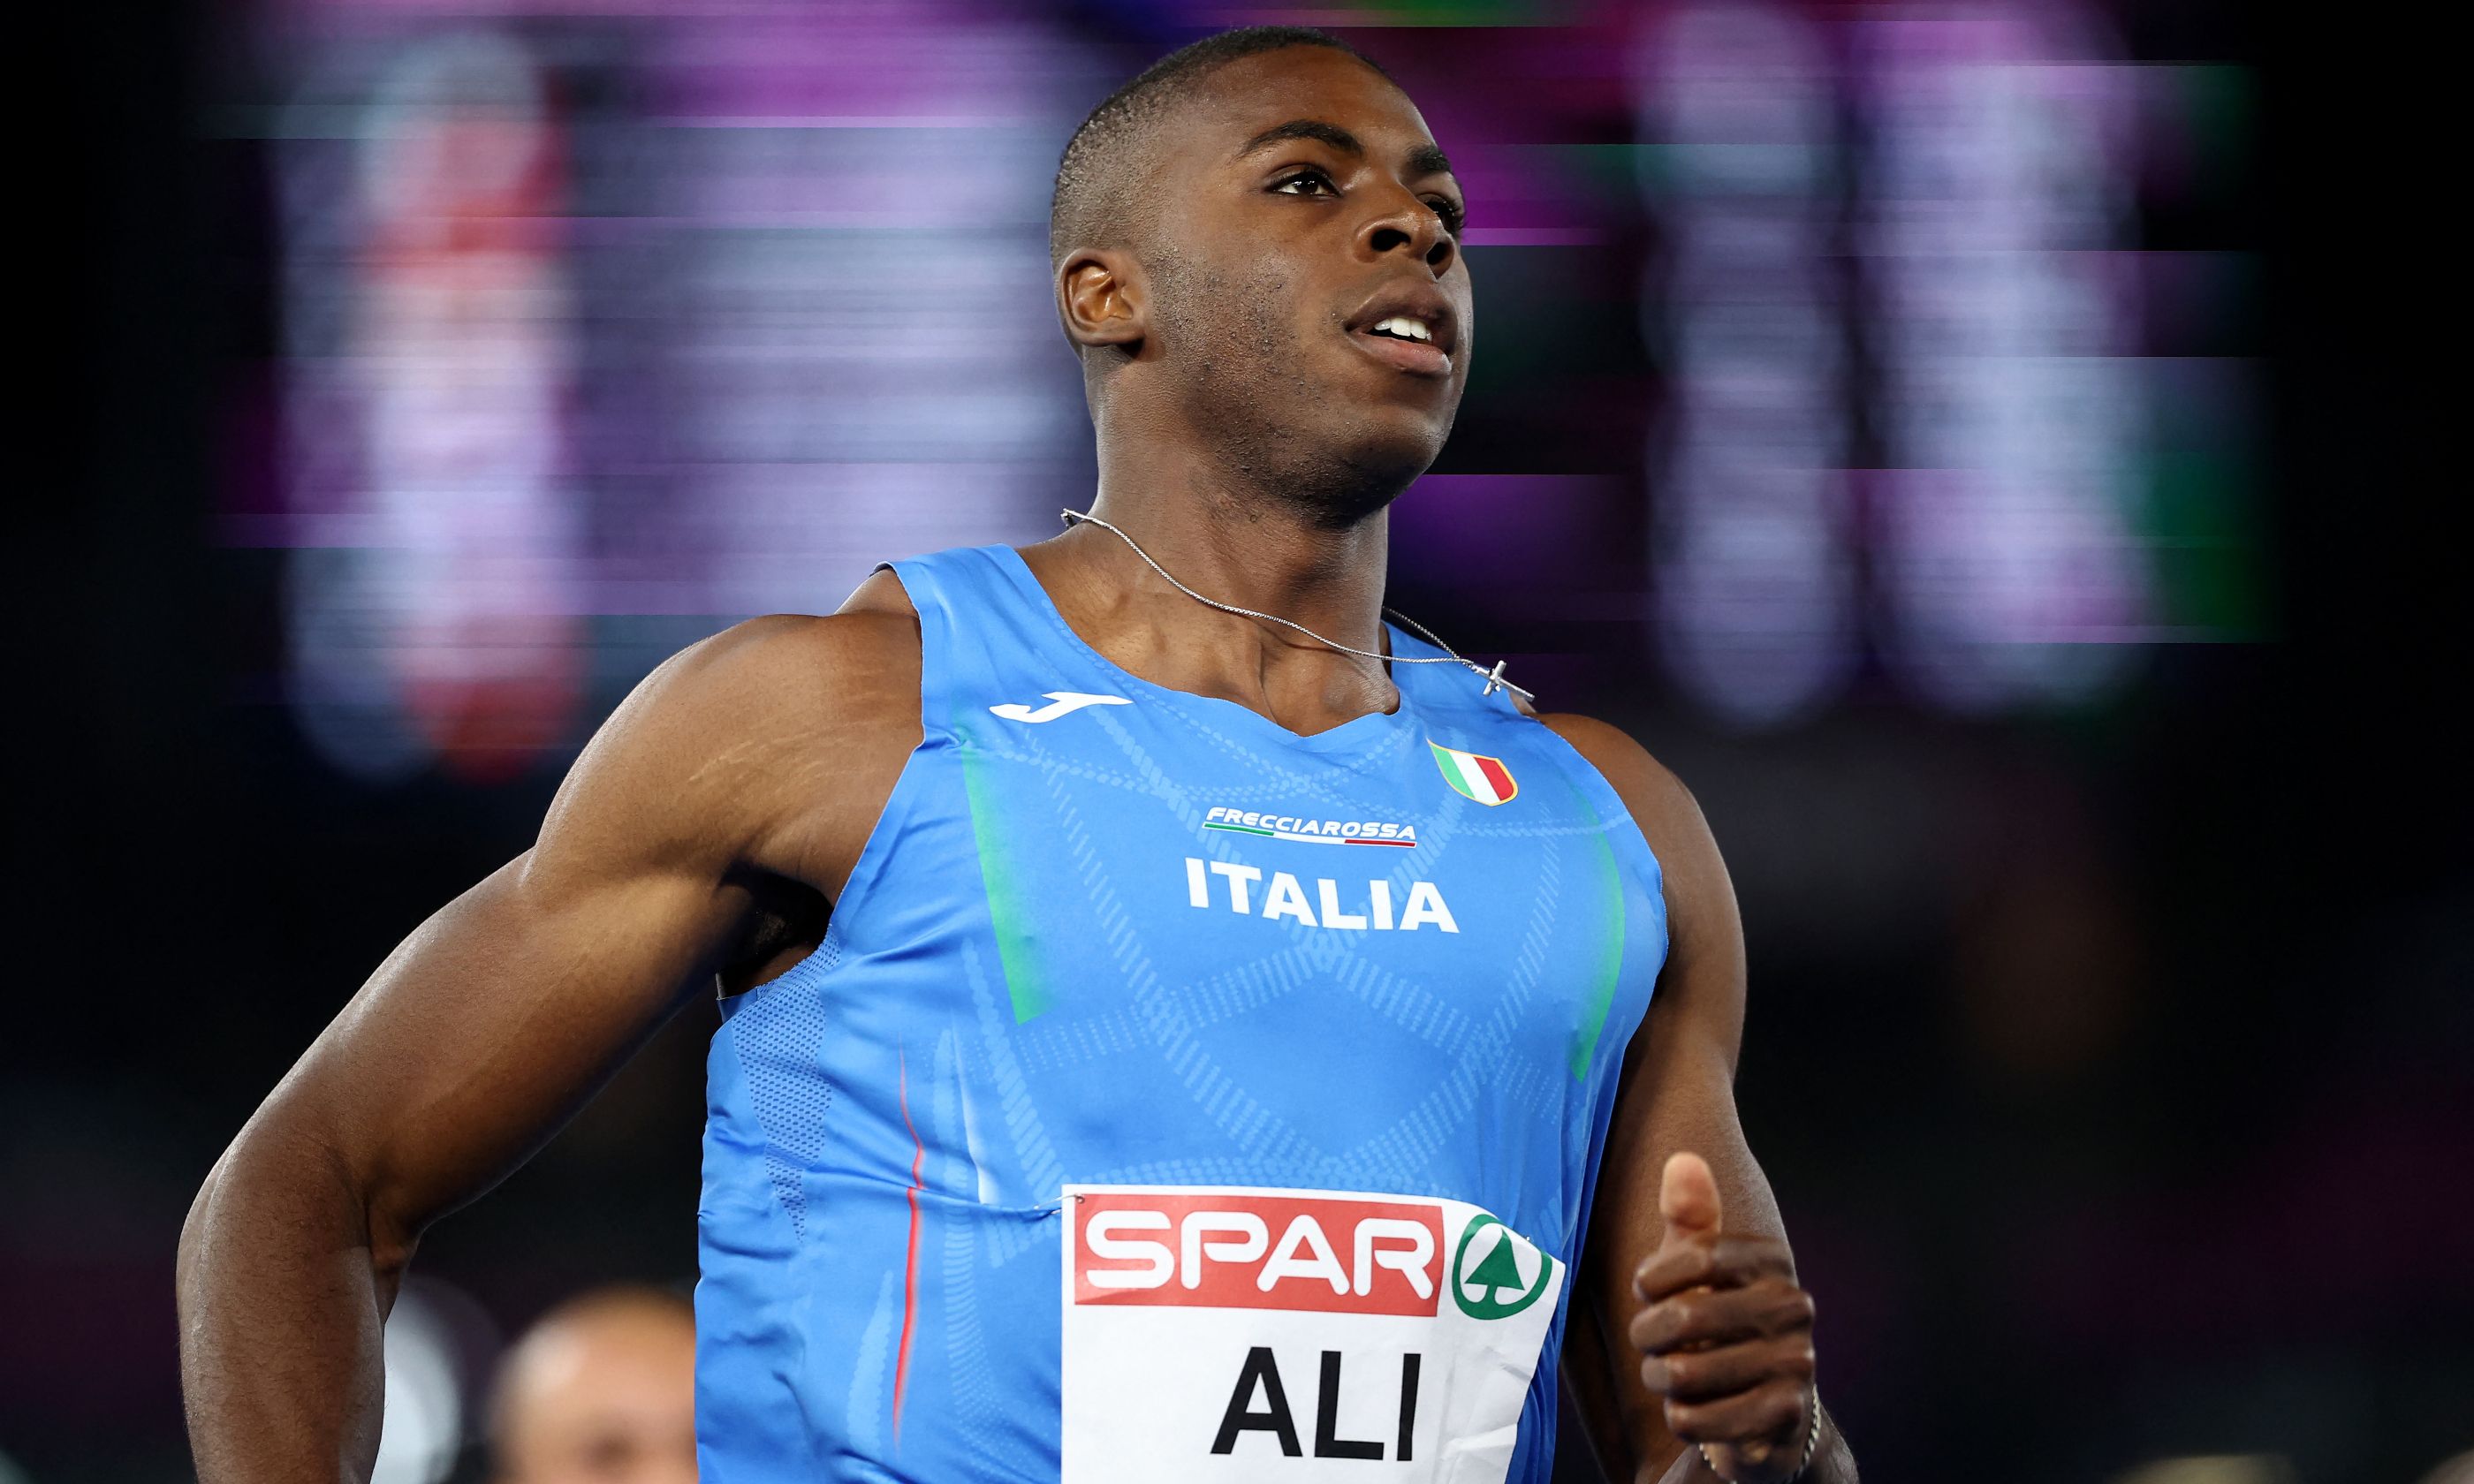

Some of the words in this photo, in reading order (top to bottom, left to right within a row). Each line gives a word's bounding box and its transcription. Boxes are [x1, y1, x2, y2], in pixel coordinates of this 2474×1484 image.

[1206, 806, 1416, 840] FRECCIAROSSA
[1185, 857, 1461, 934] ITALIA
[1085, 1209, 1435, 1300] SPAR
[1210, 1345, 1422, 1462] ALI
